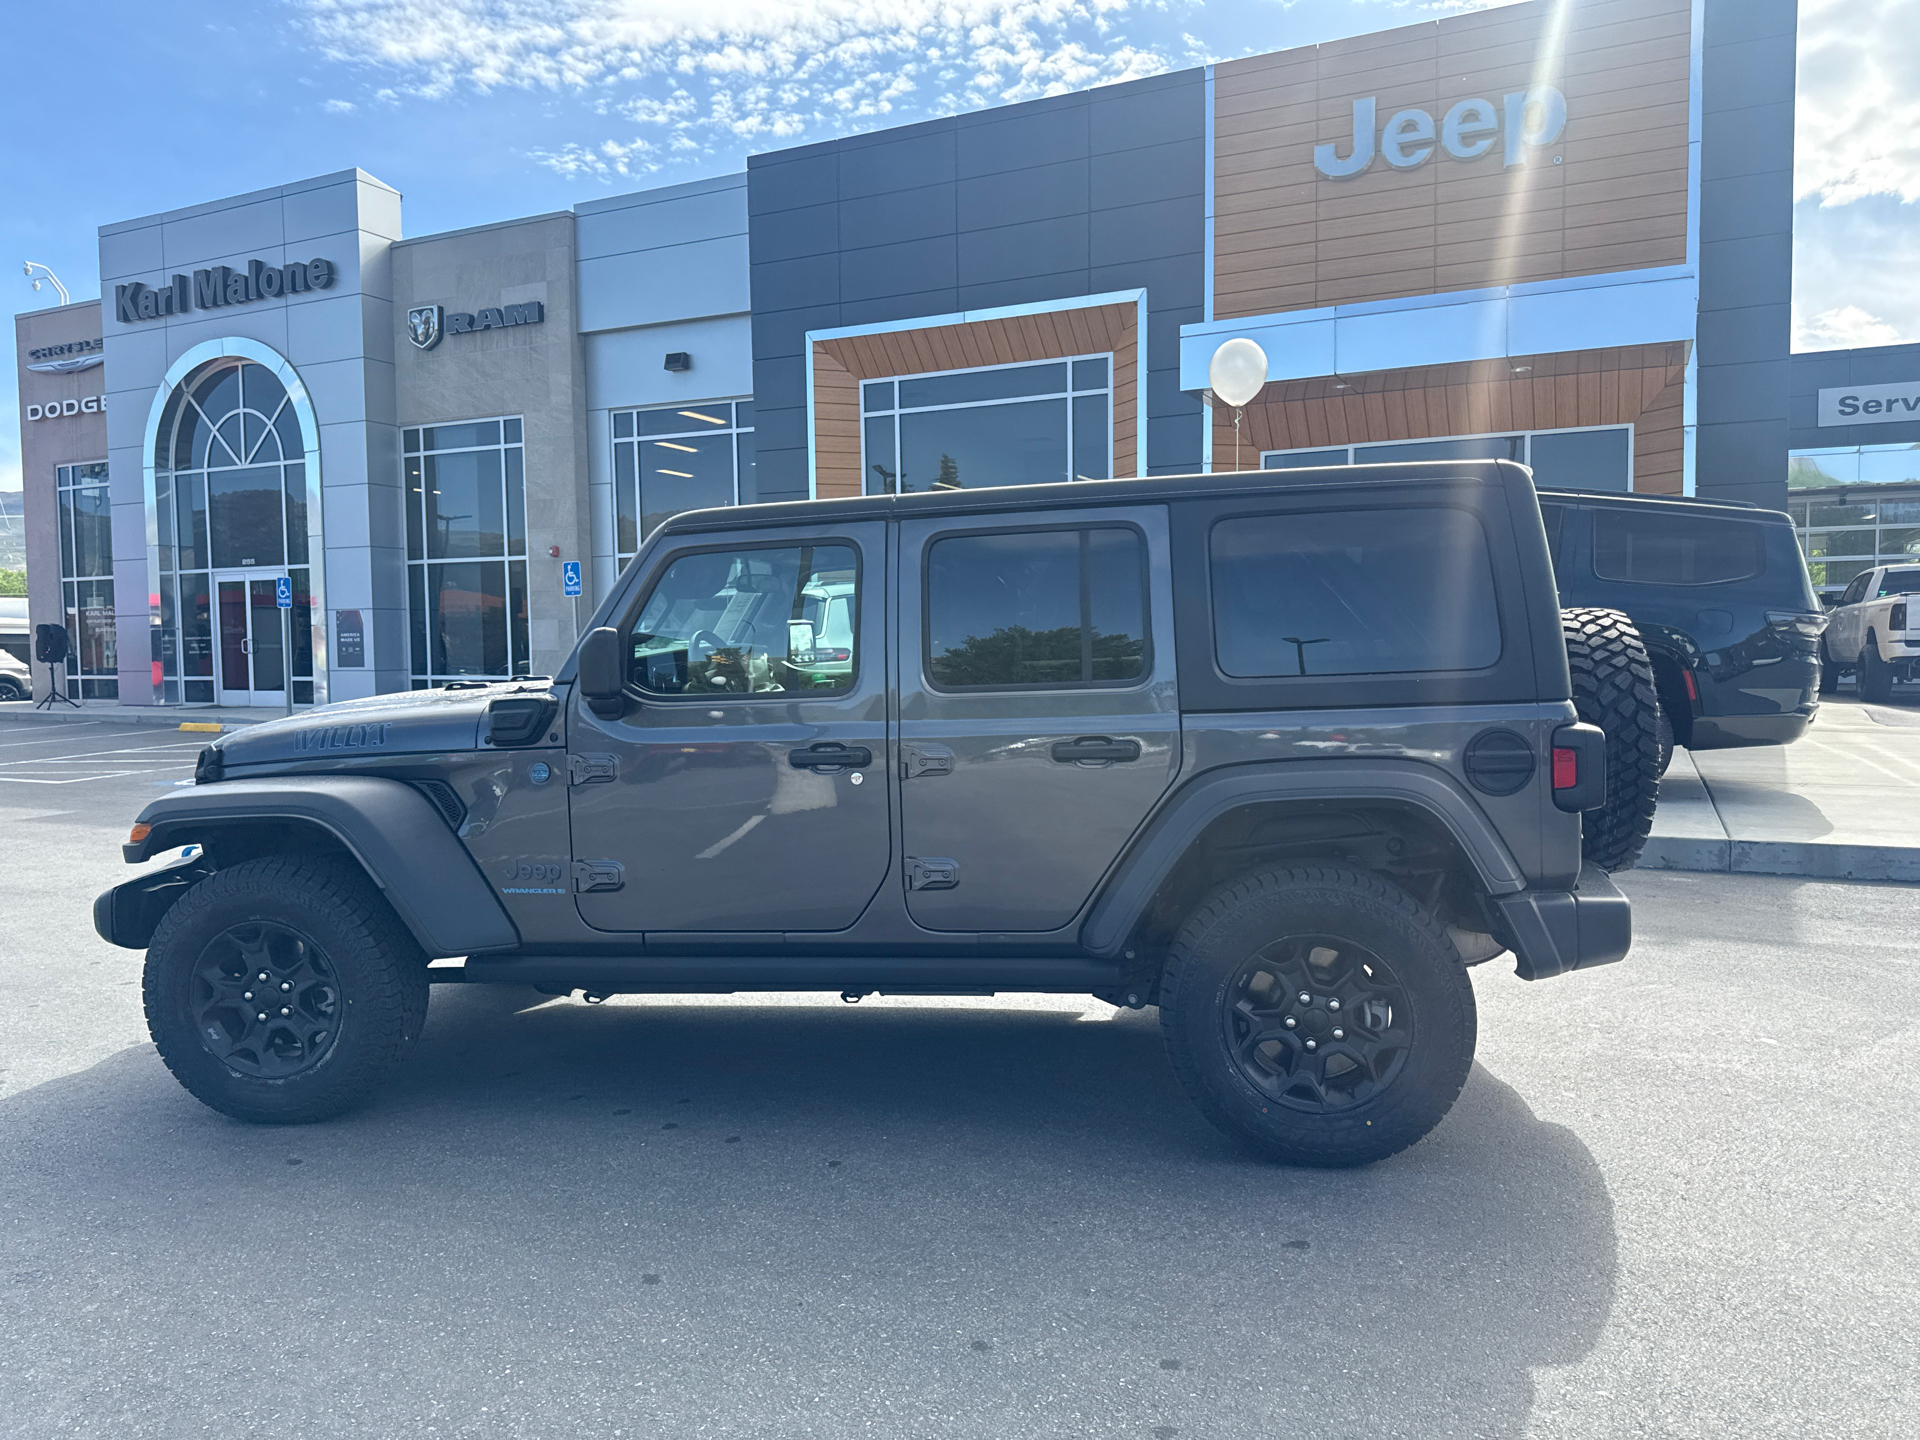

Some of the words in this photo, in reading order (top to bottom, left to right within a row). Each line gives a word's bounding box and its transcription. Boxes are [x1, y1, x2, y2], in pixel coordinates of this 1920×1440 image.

[1314, 85, 1567, 181] Jeep
[115, 273, 188, 322] Karl
[193, 257, 335, 309] Malone
[445, 301, 545, 335] RAM
[1837, 395, 1920, 416] Serv
[502, 860, 561, 884] Jeep
